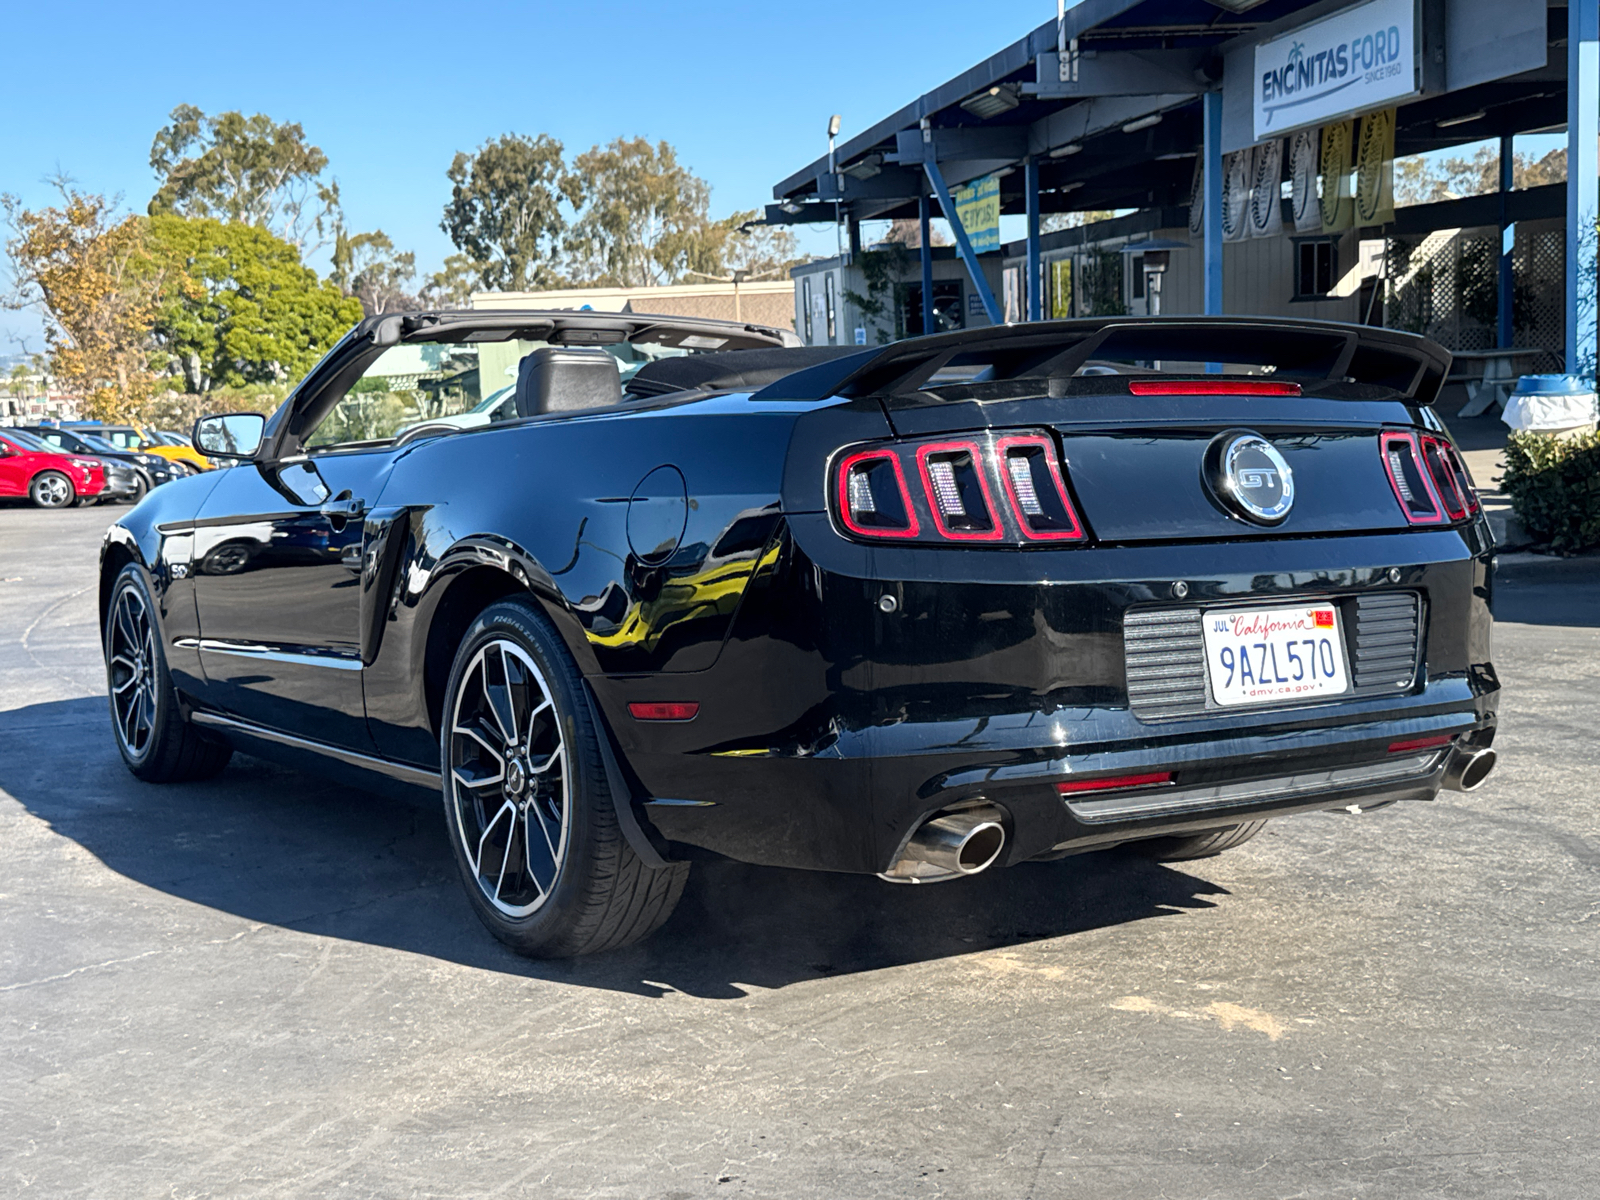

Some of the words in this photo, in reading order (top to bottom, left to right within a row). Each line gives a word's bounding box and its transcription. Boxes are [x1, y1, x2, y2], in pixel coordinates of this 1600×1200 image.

[1262, 42, 1348, 103] ENCINITAS
[1352, 25, 1400, 75] FORD
[1364, 67, 1385, 84] SINCE
[1385, 61, 1402, 79] 1960
[1239, 468, 1278, 488] GT
[1213, 620, 1229, 632] JUL
[1234, 614, 1315, 641] California
[1220, 638, 1335, 688] 9AZL570
[1249, 684, 1315, 696] dmv.ca.gov
